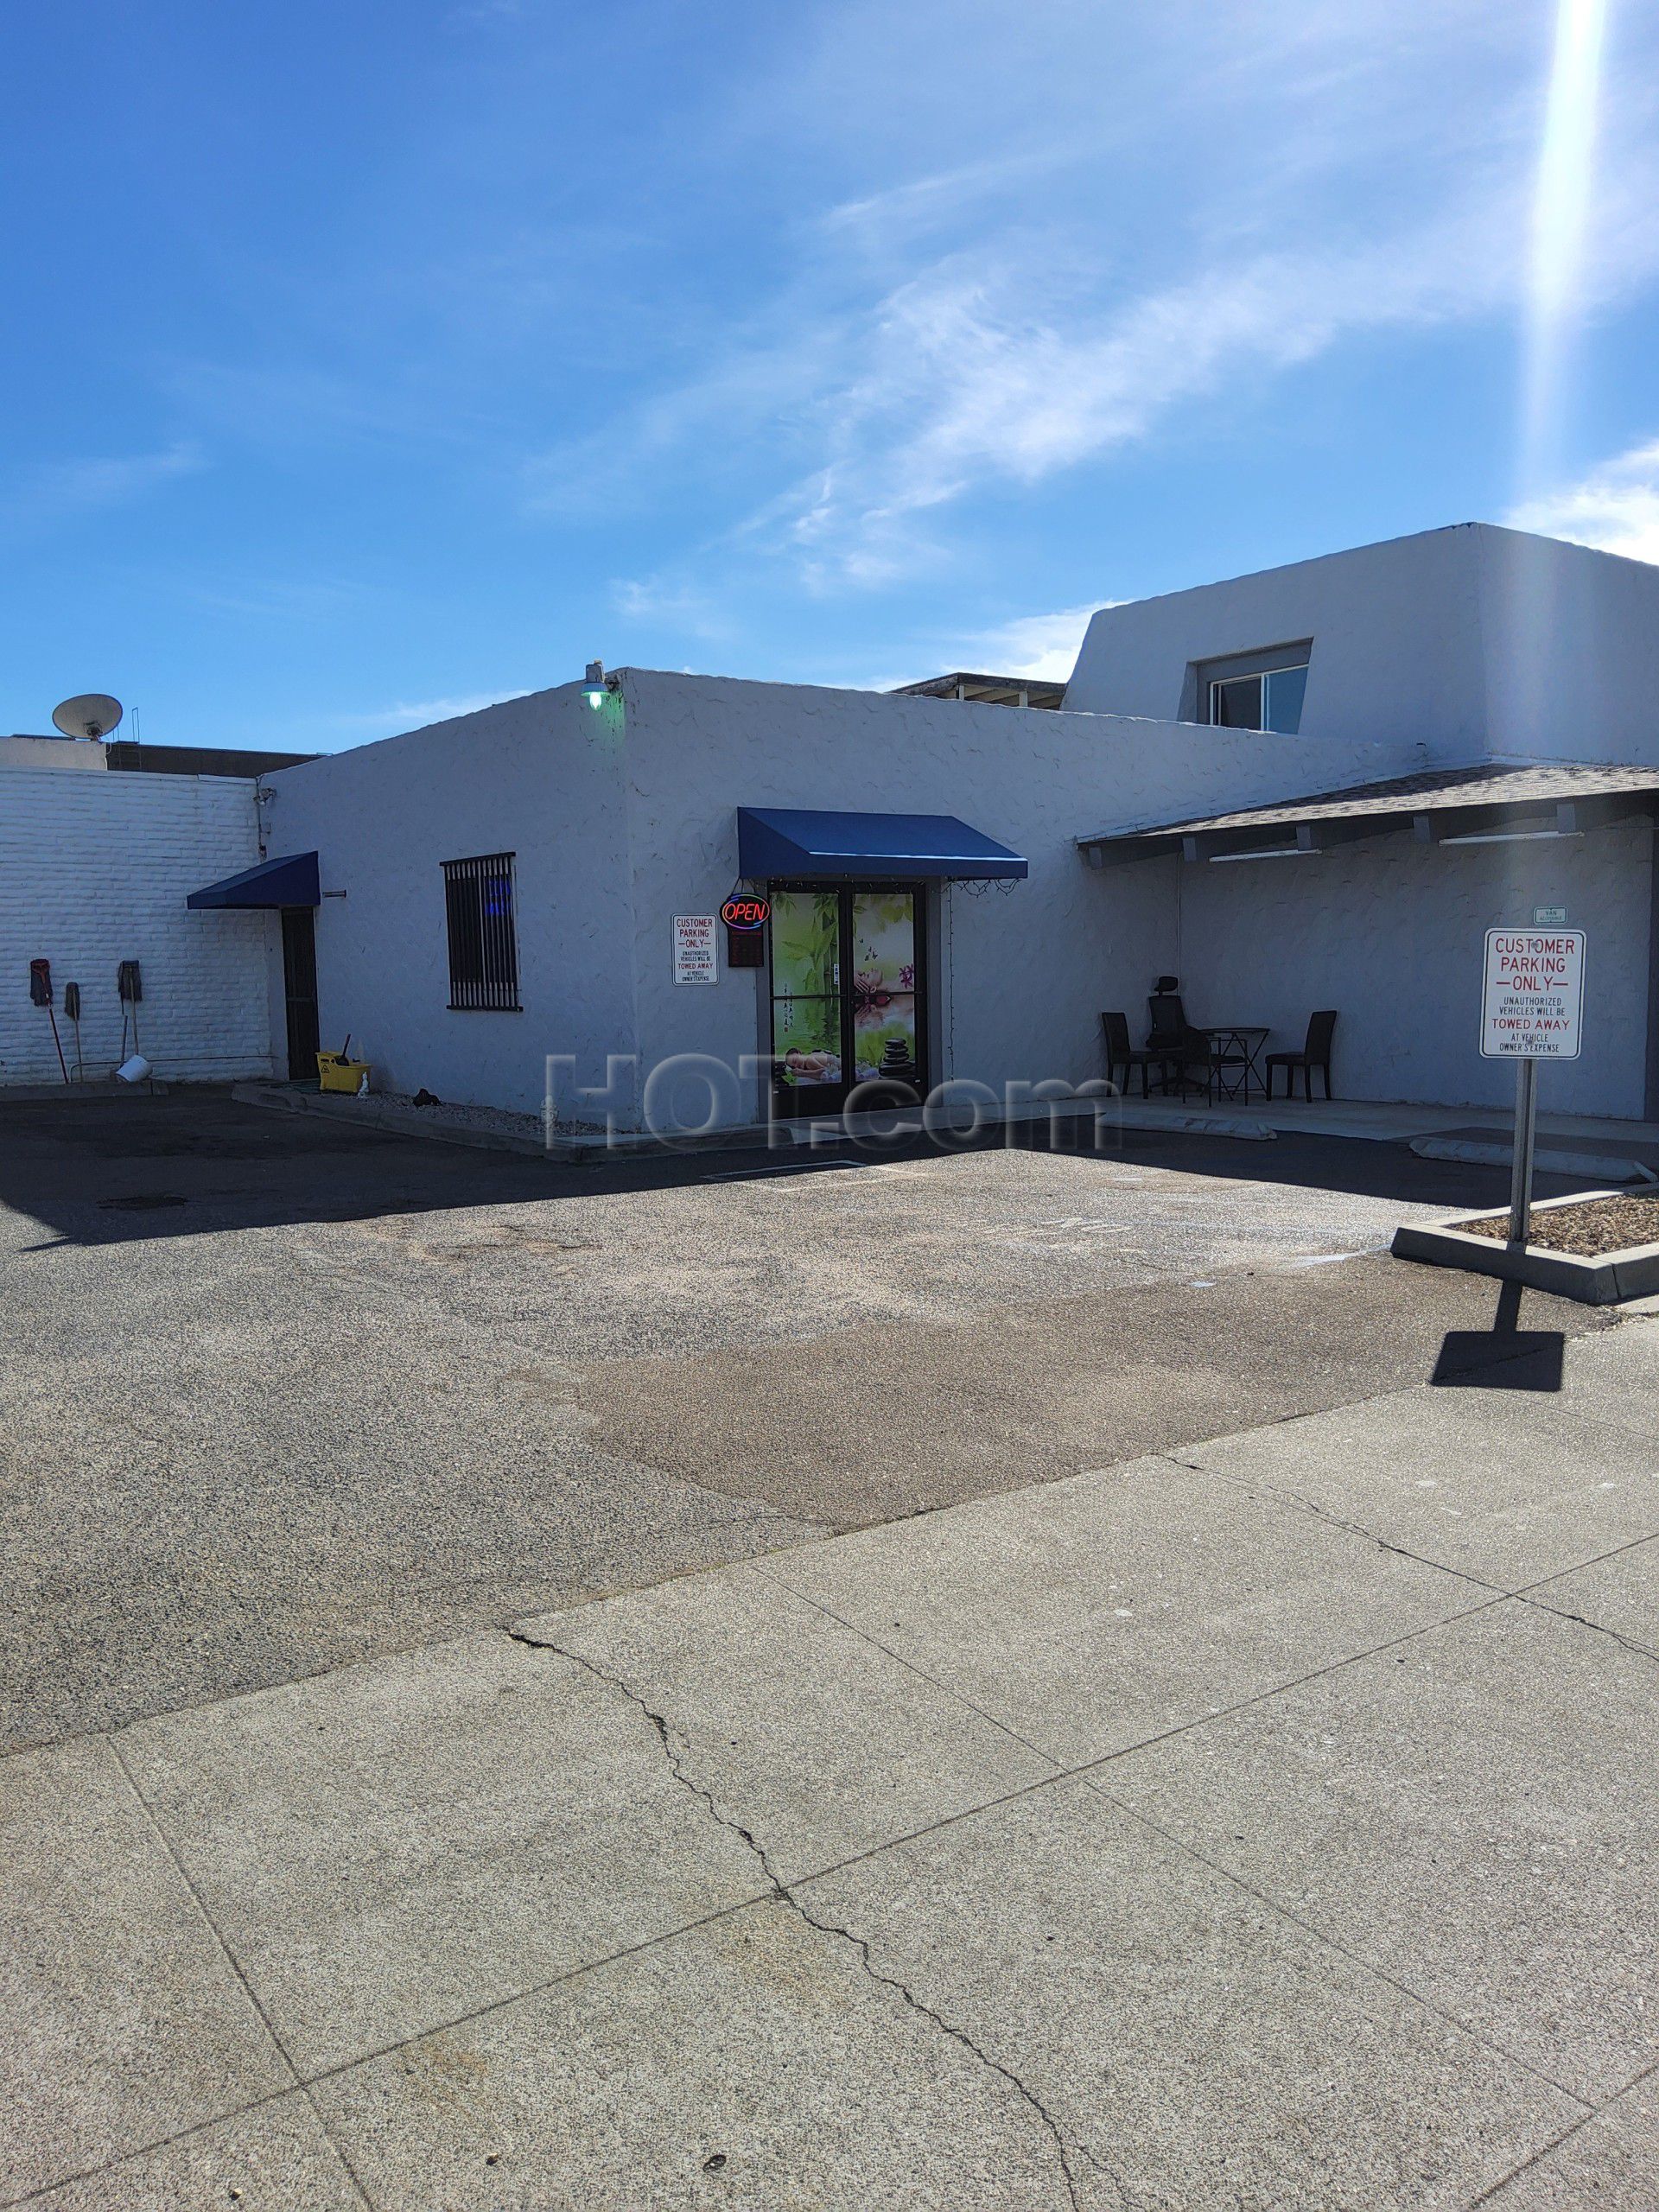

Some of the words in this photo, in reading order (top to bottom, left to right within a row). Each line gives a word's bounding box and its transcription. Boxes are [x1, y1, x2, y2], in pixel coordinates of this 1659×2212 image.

[725, 903, 766, 921] OPEN
[677, 918, 713, 927] CUSTOMER
[679, 929, 709, 938] PARKING
[1495, 938, 1575, 955] CUSTOMER
[1501, 957, 1566, 973] PARKING
[1503, 997, 1562, 1006] UNAUTHORIZED
[1499, 1007, 1535, 1016] VEHICLES
[1536, 1007, 1554, 1016] WILL
[1556, 1007, 1566, 1016] BE
[1492, 1018, 1531, 1030] TOWED
[1535, 1019, 1570, 1031] AWAY
[1522, 1033, 1548, 1042] VEHICLE
[1499, 1043, 1529, 1052] OWNER'S
[1529, 1044, 1560, 1053] EXPENSE
